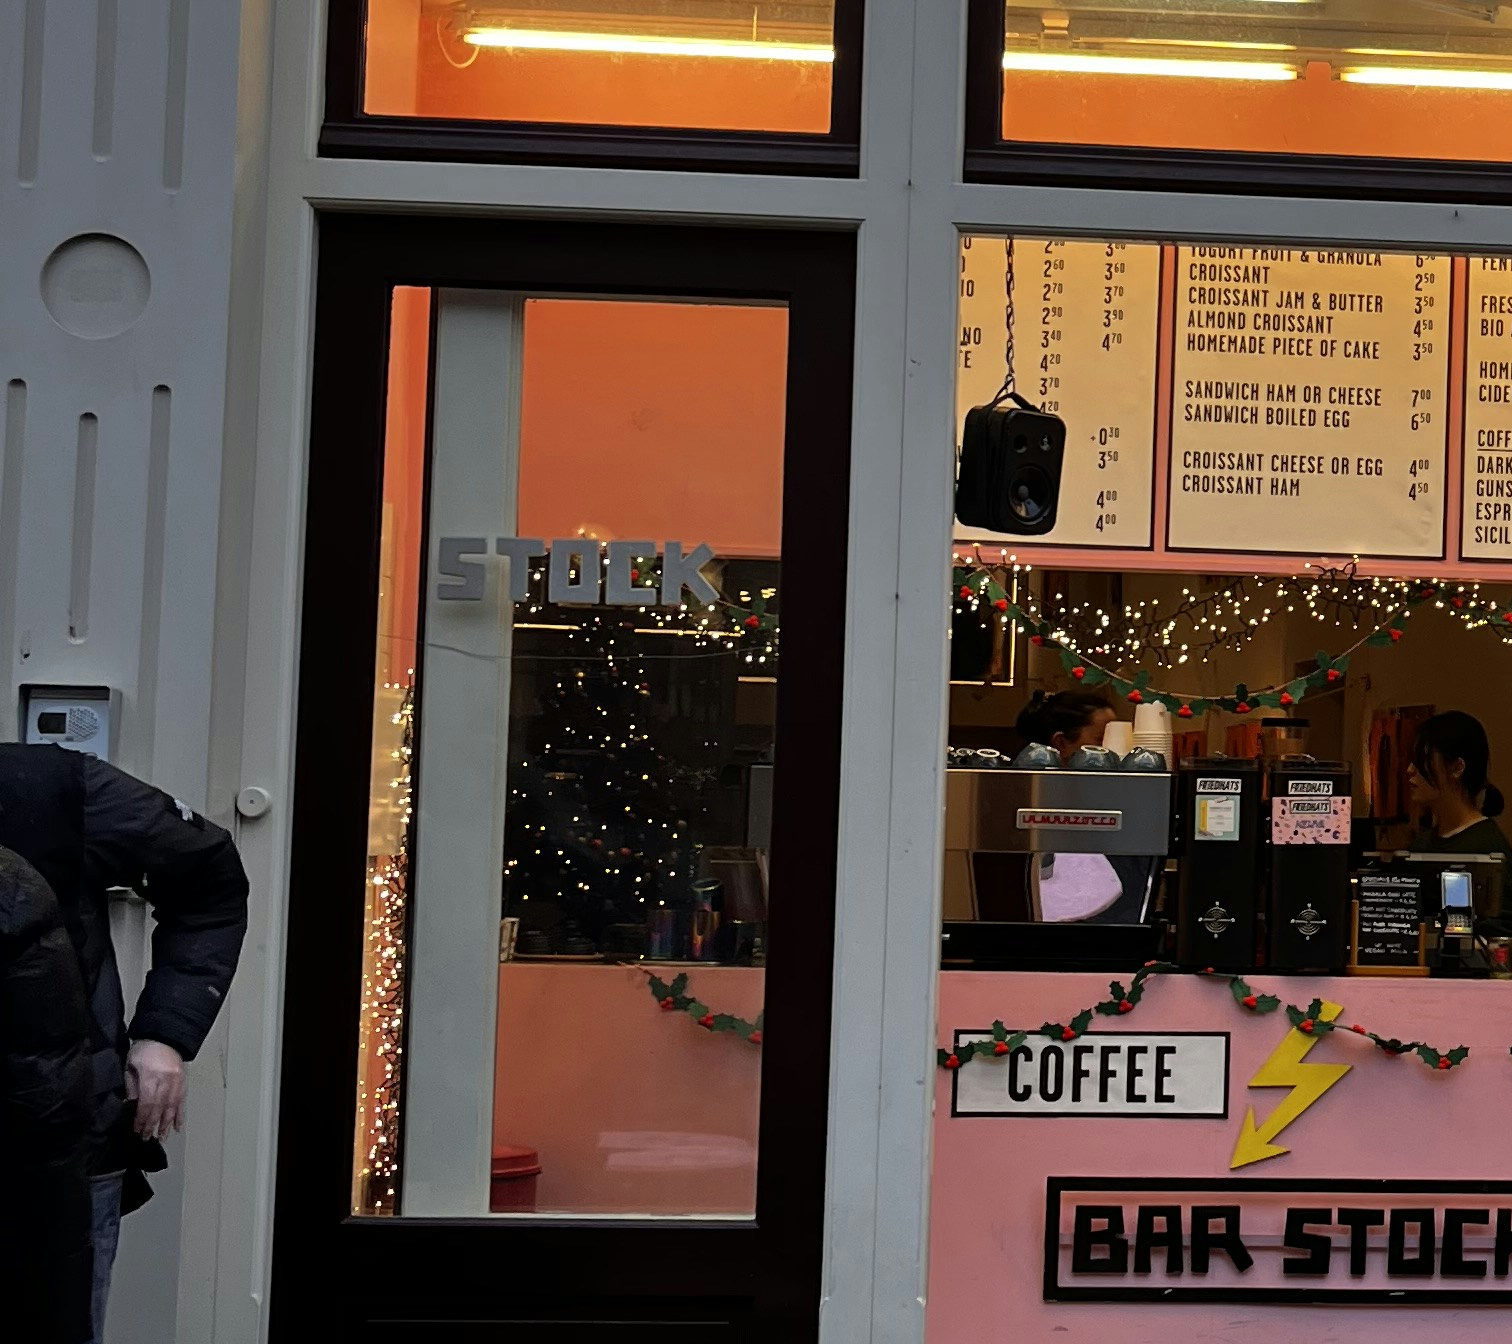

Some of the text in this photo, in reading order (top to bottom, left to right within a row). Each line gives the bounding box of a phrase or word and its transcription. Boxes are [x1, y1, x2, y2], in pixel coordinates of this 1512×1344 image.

[1317, 252, 1382, 267] GRANOLA
[1189, 263, 1270, 284] CROISSANT
[1189, 286, 1383, 313] CROISSANT JAM & BUTTER
[1187, 309, 1334, 334] ALMOND CROISSANT
[1481, 318, 1504, 337] BIO
[1187, 333, 1380, 359] HOMEMADE PIECE OF CAKE
[1185, 380, 1382, 406] SANDWICH HAM OR CHEESE
[1185, 403, 1350, 428] SANDWICH BOILED EGG
[1183, 451, 1383, 476] CROISSANT CHEESE OR EGG
[1182, 474, 1300, 496] CROISSANT HAM
[1476, 479, 1512, 498] GUNS
[437, 536, 720, 605] STOCK
[1006, 1044, 1177, 1104] COFFEE
[1070, 1204, 1255, 1276] BAR
